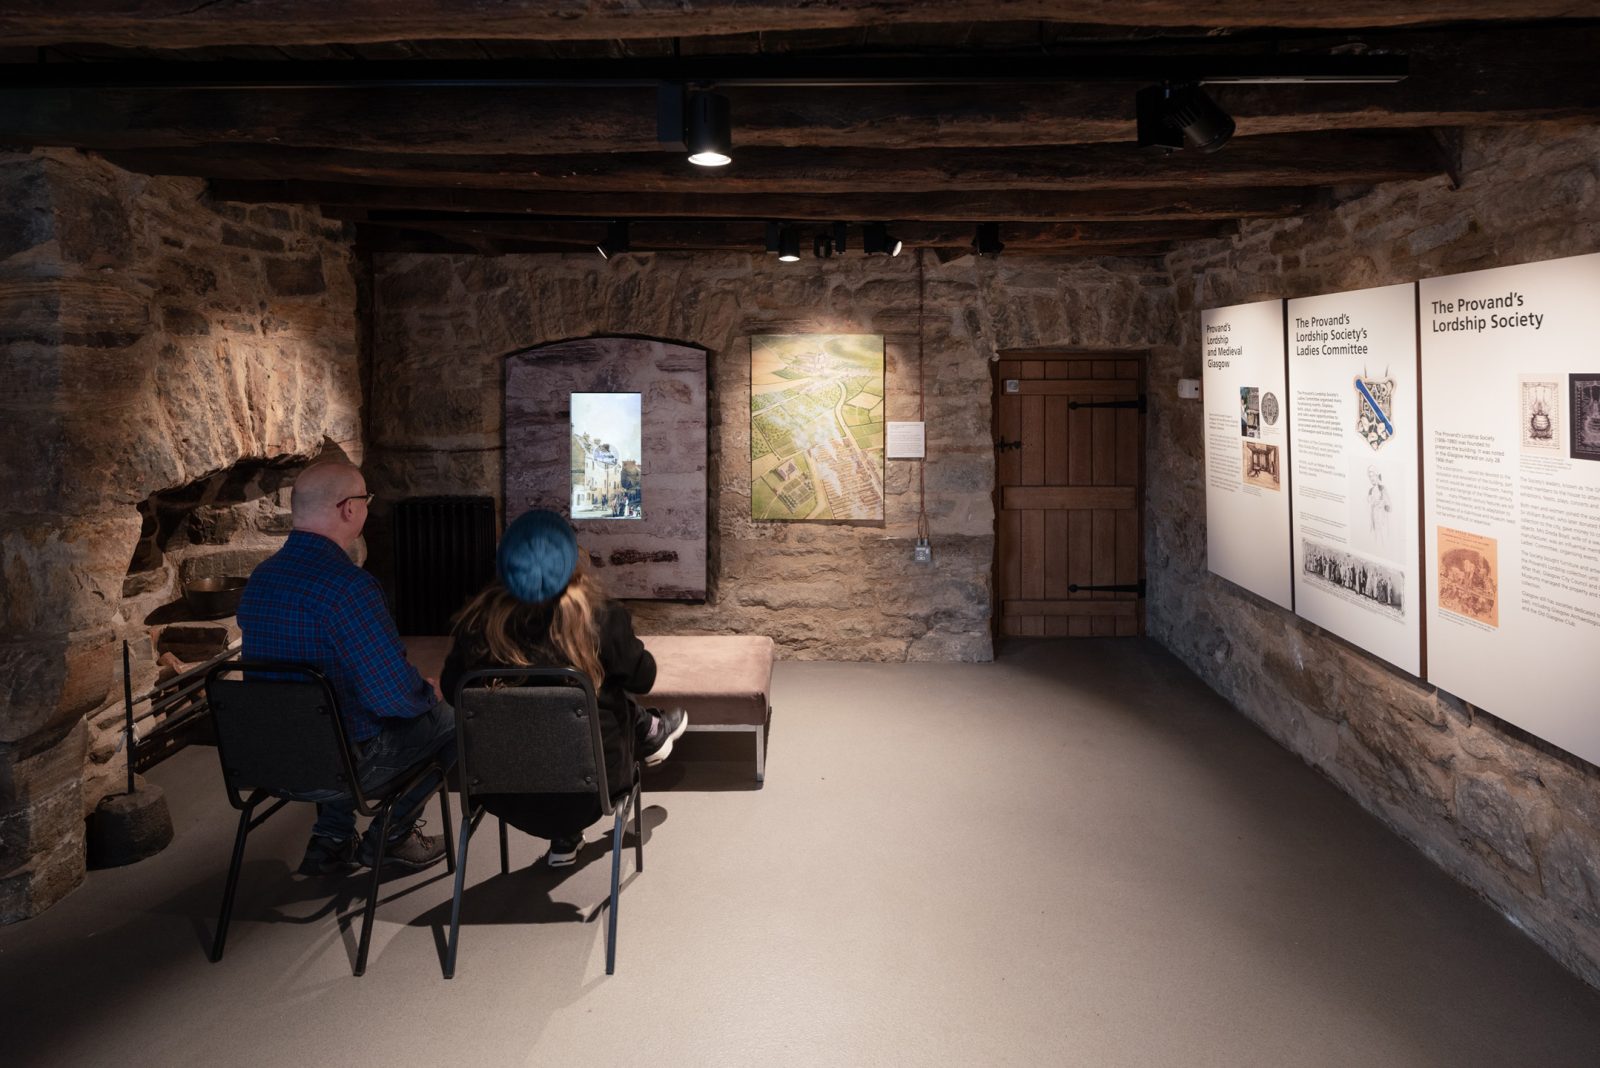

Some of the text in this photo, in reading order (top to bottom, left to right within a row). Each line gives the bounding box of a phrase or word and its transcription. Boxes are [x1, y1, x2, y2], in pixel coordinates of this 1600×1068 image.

[1432, 292, 1524, 314] The Provand's
[1296, 313, 1350, 328] The Provand's
[1432, 312, 1544, 333] Lordship Society
[1206, 323, 1231, 333] Provand's
[1207, 335, 1229, 345] Lordship
[1296, 328, 1368, 343] Lordship Society's
[1208, 346, 1242, 356] and Medieval
[1296, 344, 1368, 356] Ladies Committee
[1208, 359, 1230, 370] Glasgow
